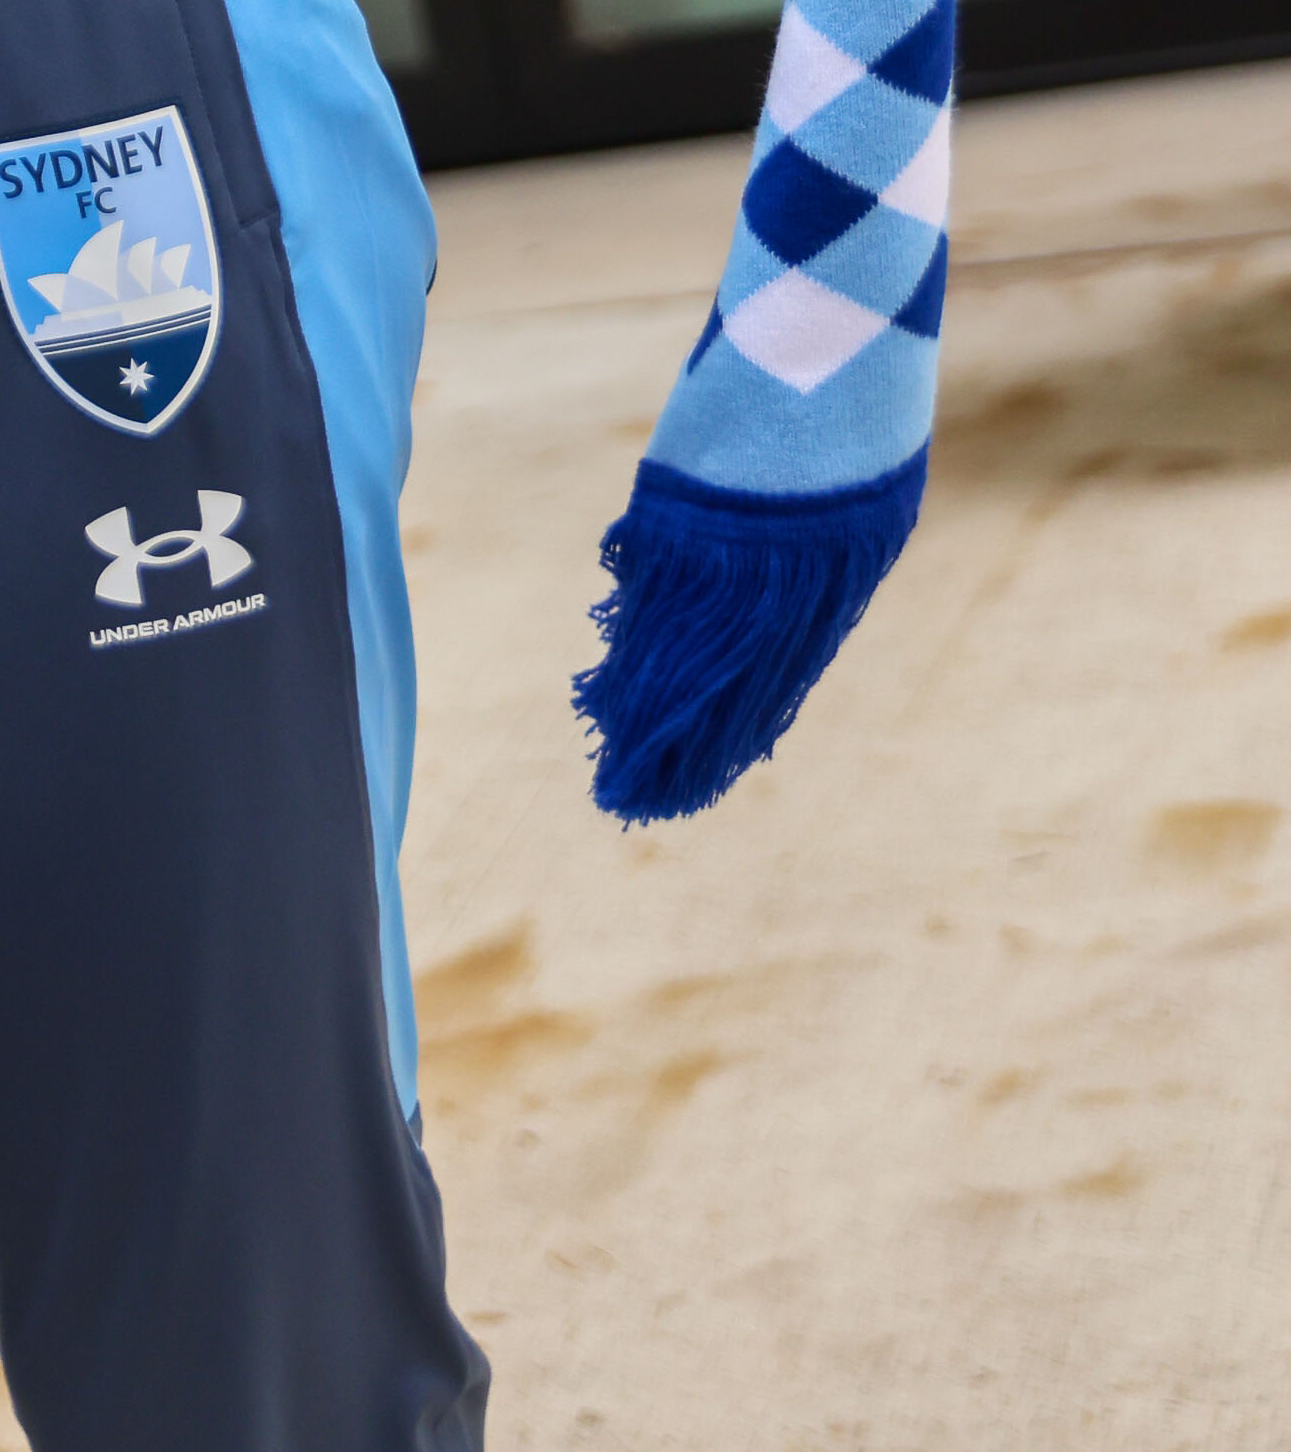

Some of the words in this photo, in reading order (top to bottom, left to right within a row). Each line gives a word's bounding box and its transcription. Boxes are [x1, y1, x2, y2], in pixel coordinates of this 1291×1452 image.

[75, 186, 117, 219] FC
[89, 618, 170, 646] UNDER
[172, 593, 267, 631] ARMOUR
